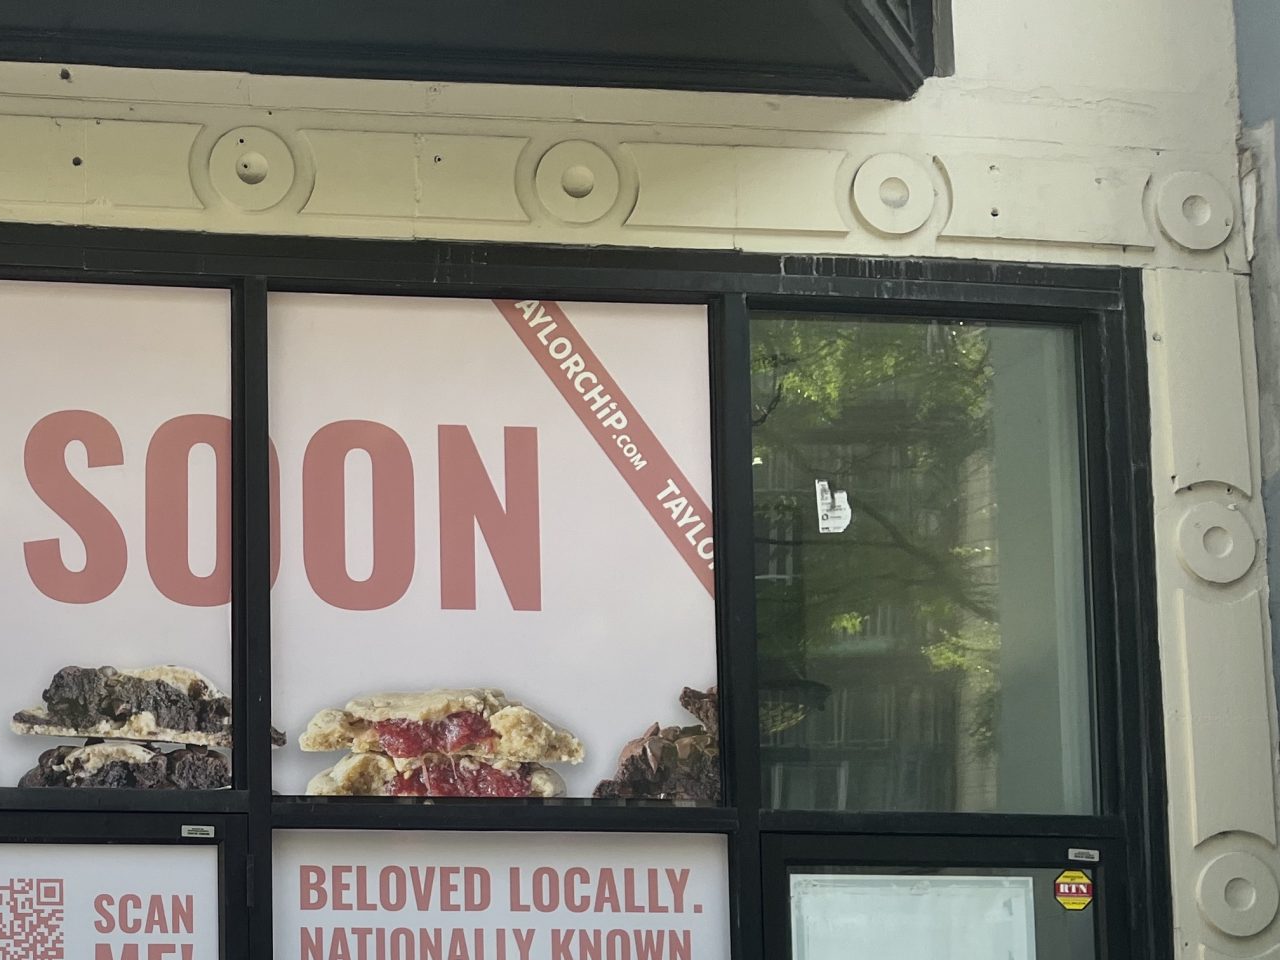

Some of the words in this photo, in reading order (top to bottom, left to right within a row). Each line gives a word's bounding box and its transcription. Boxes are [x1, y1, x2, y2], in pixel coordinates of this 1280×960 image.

[23, 409, 542, 611] SOON
[299, 865, 491, 912] BELOVED
[509, 866, 704, 913] LOCALLY.
[93, 893, 194, 934] SCAN
